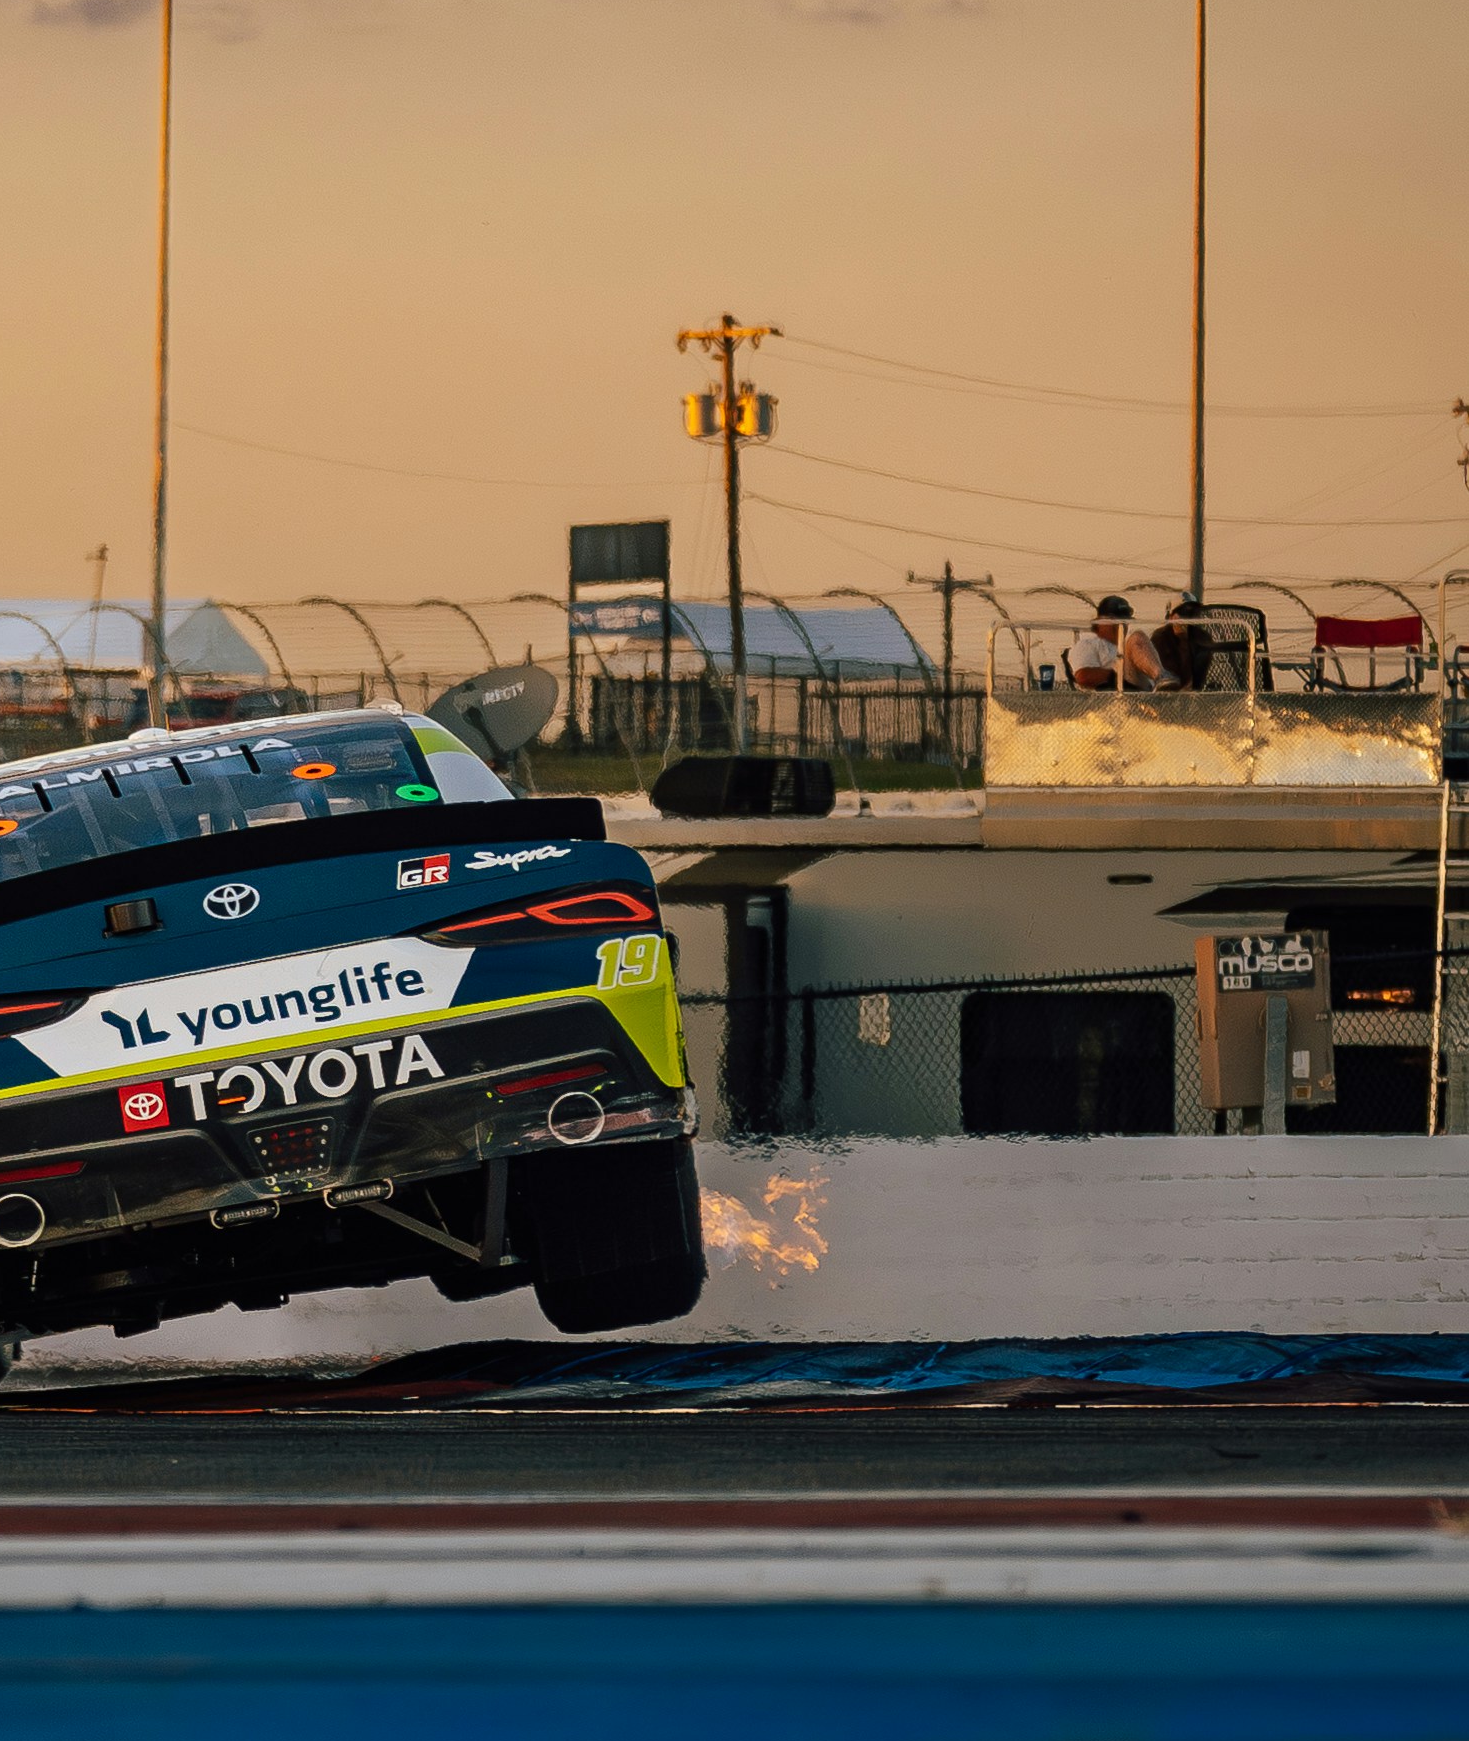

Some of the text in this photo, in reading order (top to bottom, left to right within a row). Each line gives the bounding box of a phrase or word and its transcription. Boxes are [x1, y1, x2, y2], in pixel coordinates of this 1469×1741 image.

[400, 865, 449, 887] GR
[465, 845, 571, 872] Supra
[596, 934, 662, 991] 19
[177, 962, 425, 1046] younglife
[174, 1034, 445, 1121] TOYOTA
